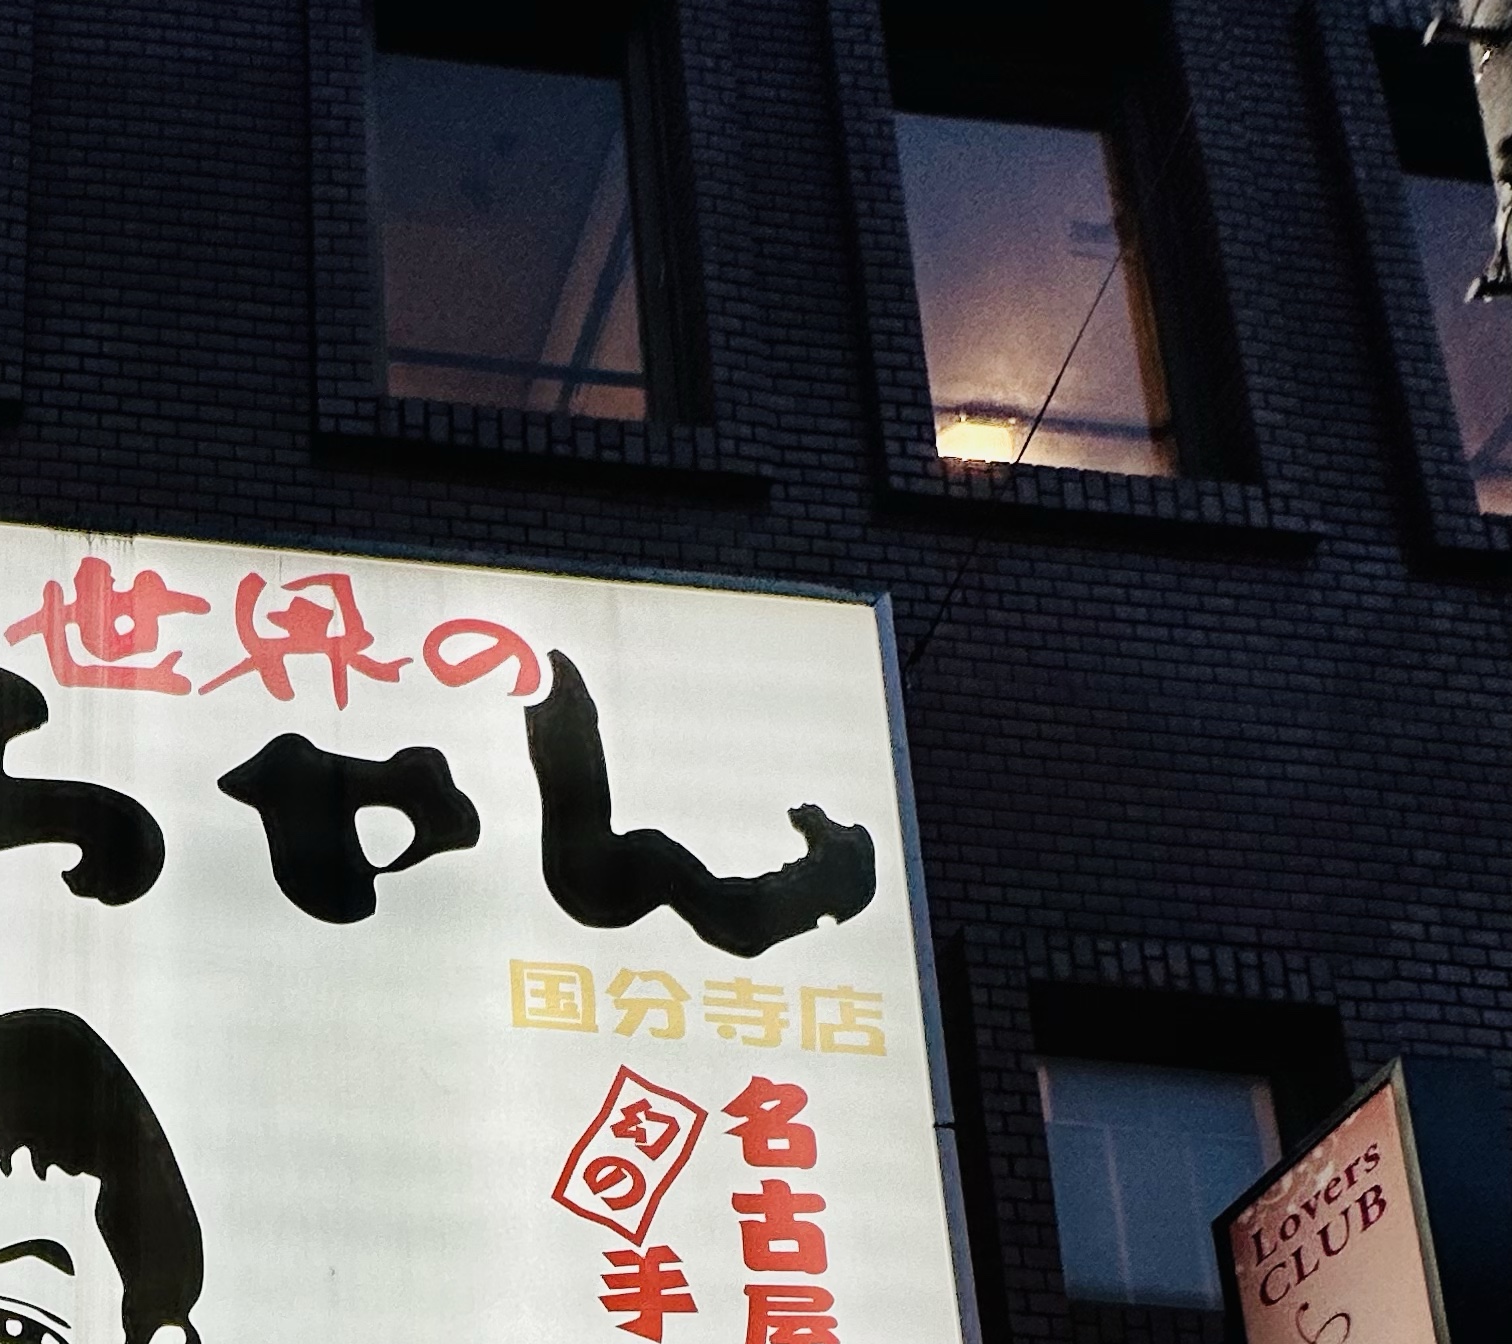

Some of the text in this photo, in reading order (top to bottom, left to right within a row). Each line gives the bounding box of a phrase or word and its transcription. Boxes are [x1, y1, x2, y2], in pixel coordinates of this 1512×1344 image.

[4, 556, 542, 711] 世界の
[509, 959, 888, 1057] 国分寺店
[1251, 1141, 1383, 1268] Lovers
[1257, 1181, 1389, 1308] CLUB
